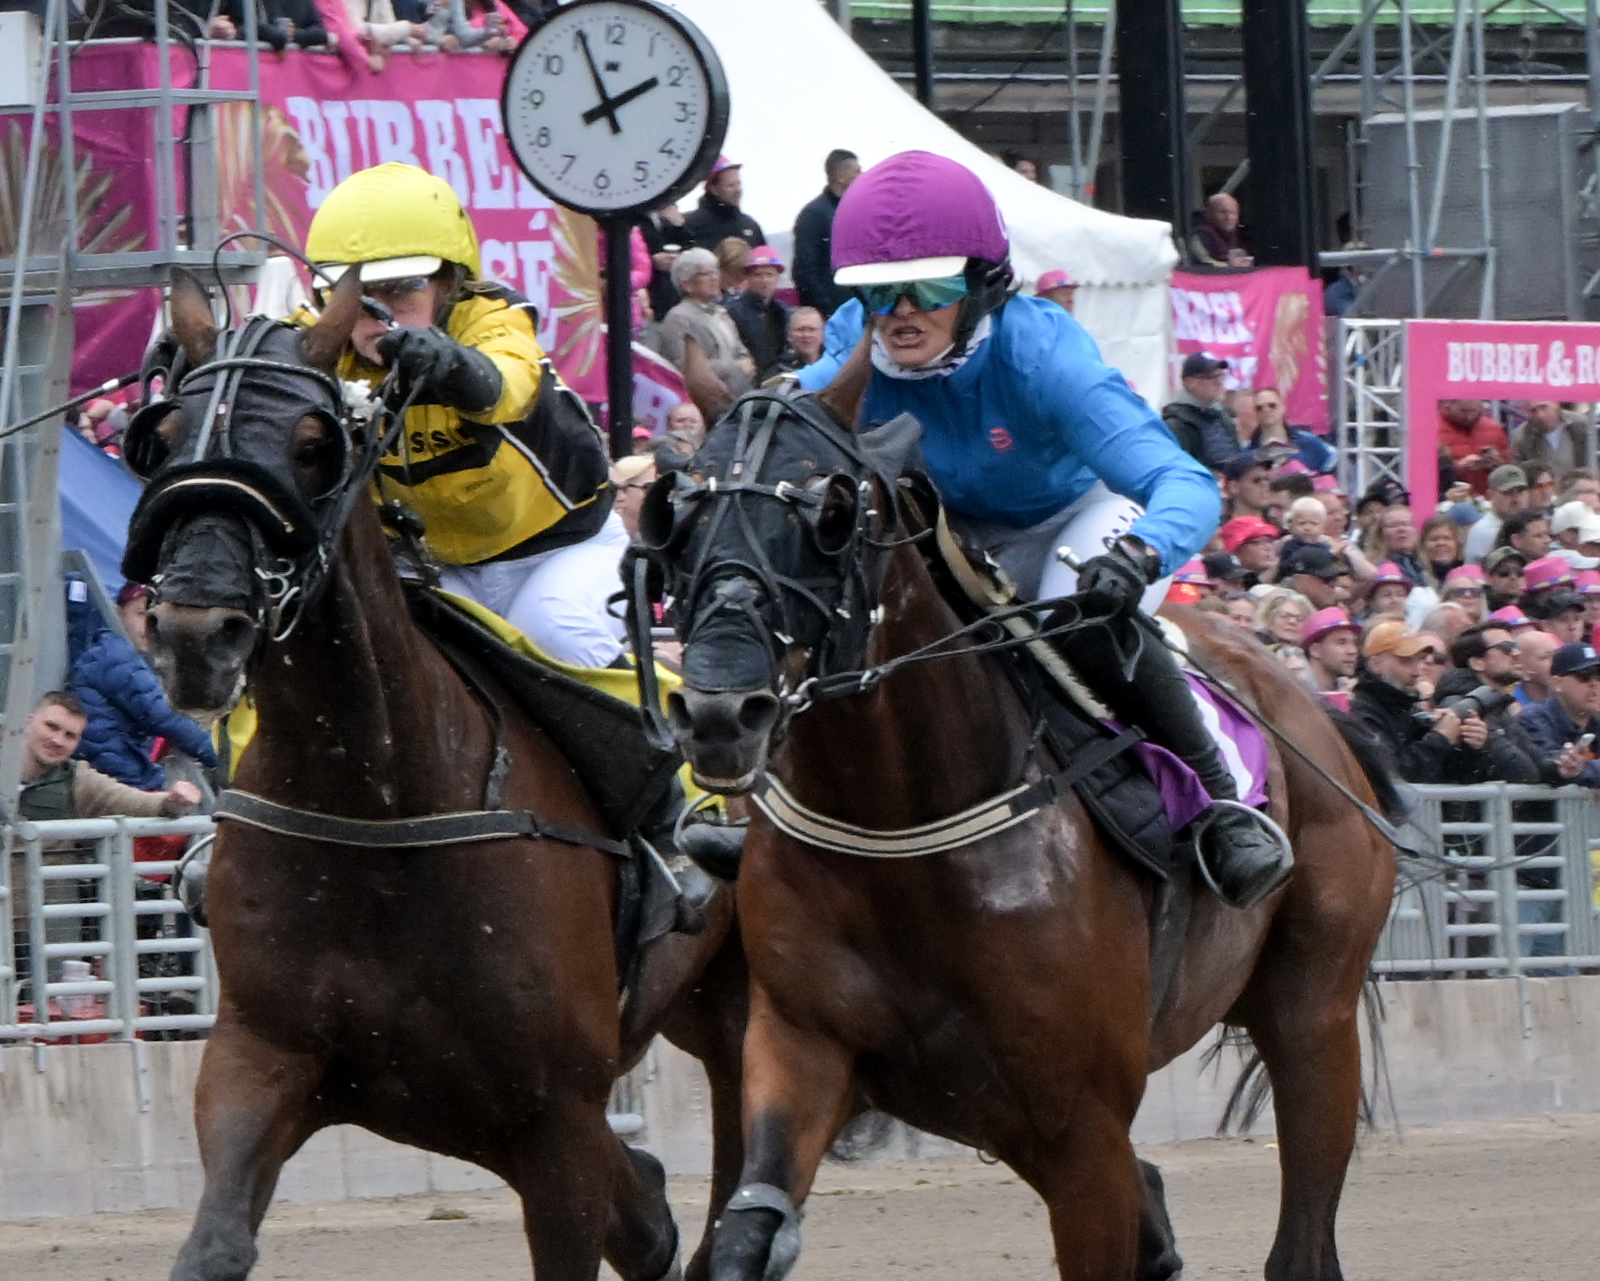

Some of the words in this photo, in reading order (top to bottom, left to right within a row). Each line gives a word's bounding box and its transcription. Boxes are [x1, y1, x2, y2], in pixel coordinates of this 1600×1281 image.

[604, 22, 626, 45] 12
[648, 32, 661, 58] 1
[544, 54, 564, 77] 10
[666, 65, 686, 87] 2
[528, 89, 545, 110] 9
[674, 101, 692, 123] 3
[537, 126, 551, 149] 8
[658, 138, 675, 156] 4
[560, 154, 577, 176] 7
[632, 160, 650, 184] 5
[593, 168, 612, 191] 6
[1447, 341, 1544, 384] BUBBEL
[1546, 339, 1575, 387] &
[1576, 345, 1600, 386] R
